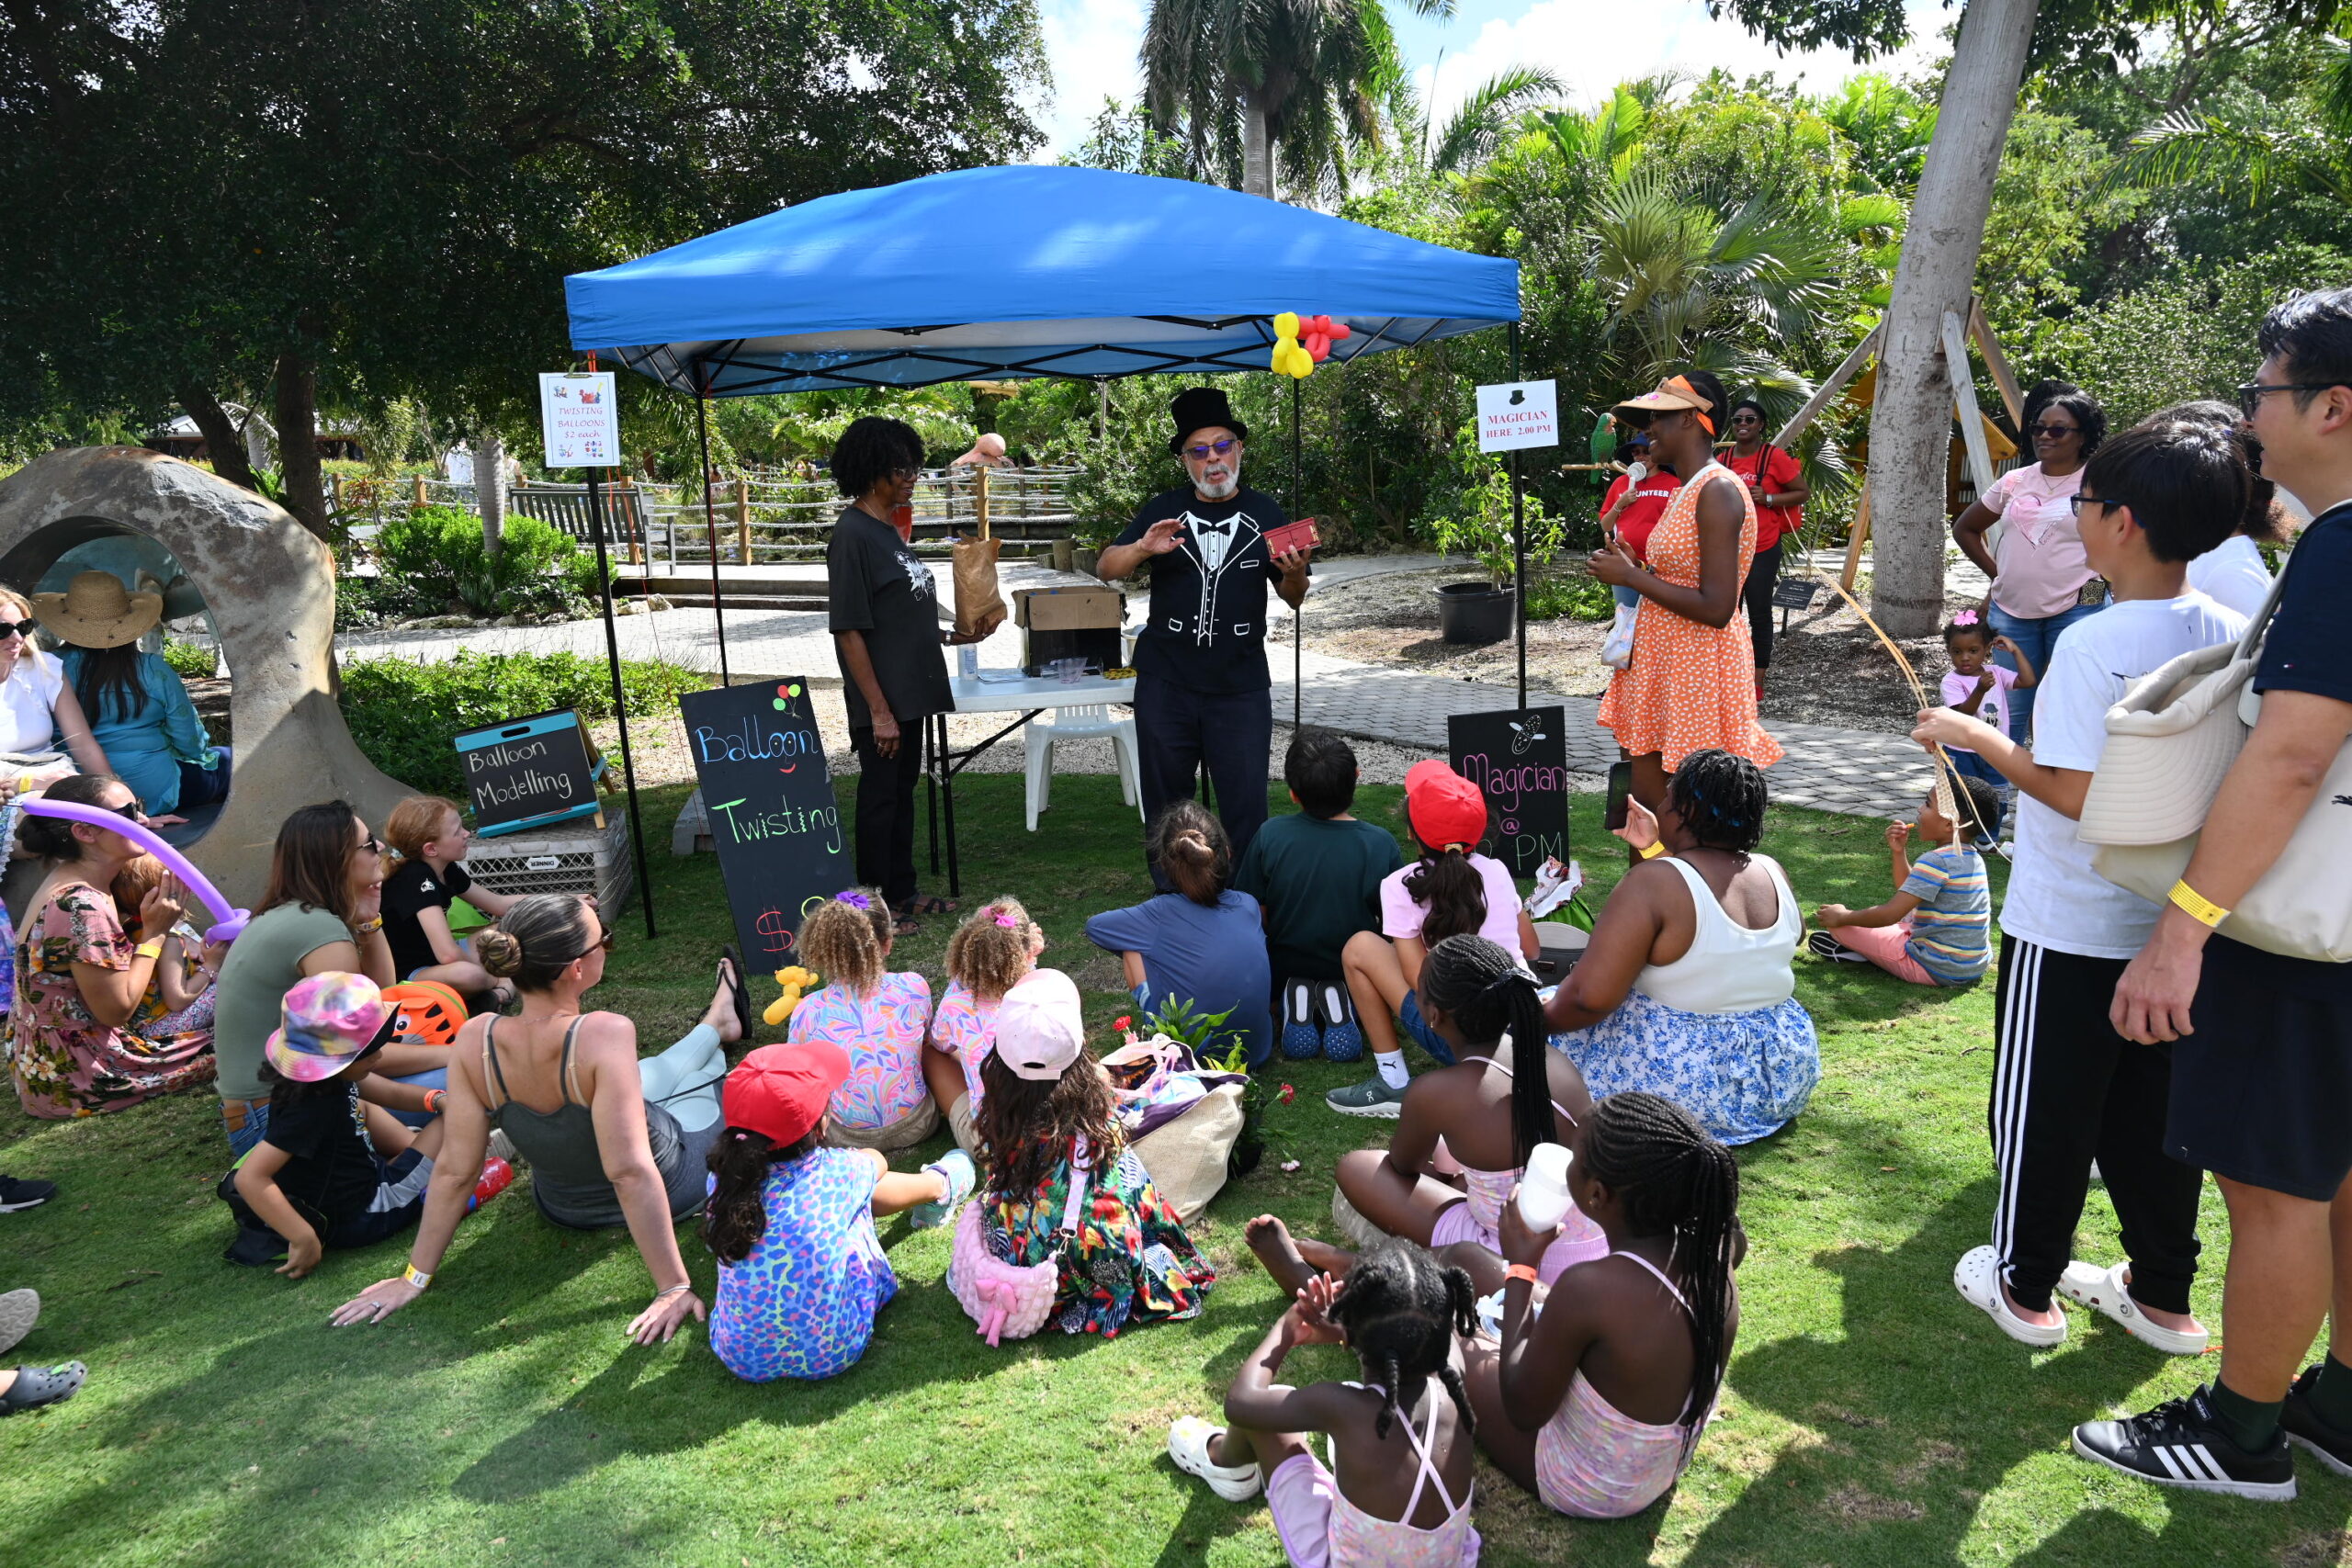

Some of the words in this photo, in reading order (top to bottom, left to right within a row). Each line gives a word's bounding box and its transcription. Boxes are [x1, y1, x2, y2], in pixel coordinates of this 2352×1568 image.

[559, 407, 603, 415] TWISTING
[1487, 411, 1548, 425] MAGICIAN
[558, 420, 605, 428] BALLOONS
[565, 431, 575, 439] $2
[578, 430, 601, 438] each
[1486, 428, 1513, 438] HERE
[1518, 426, 1534, 435] 2.00
[1537, 424, 1552, 434] PM
[695, 715, 819, 764] Balloon
[469, 741, 547, 773] Balloon
[476, 769, 572, 810] Modelling
[1464, 753, 1566, 812] Magician
[711, 795, 841, 853] Twisting
[1500, 818, 1520, 835] @
[1516, 831, 1562, 871] PM
